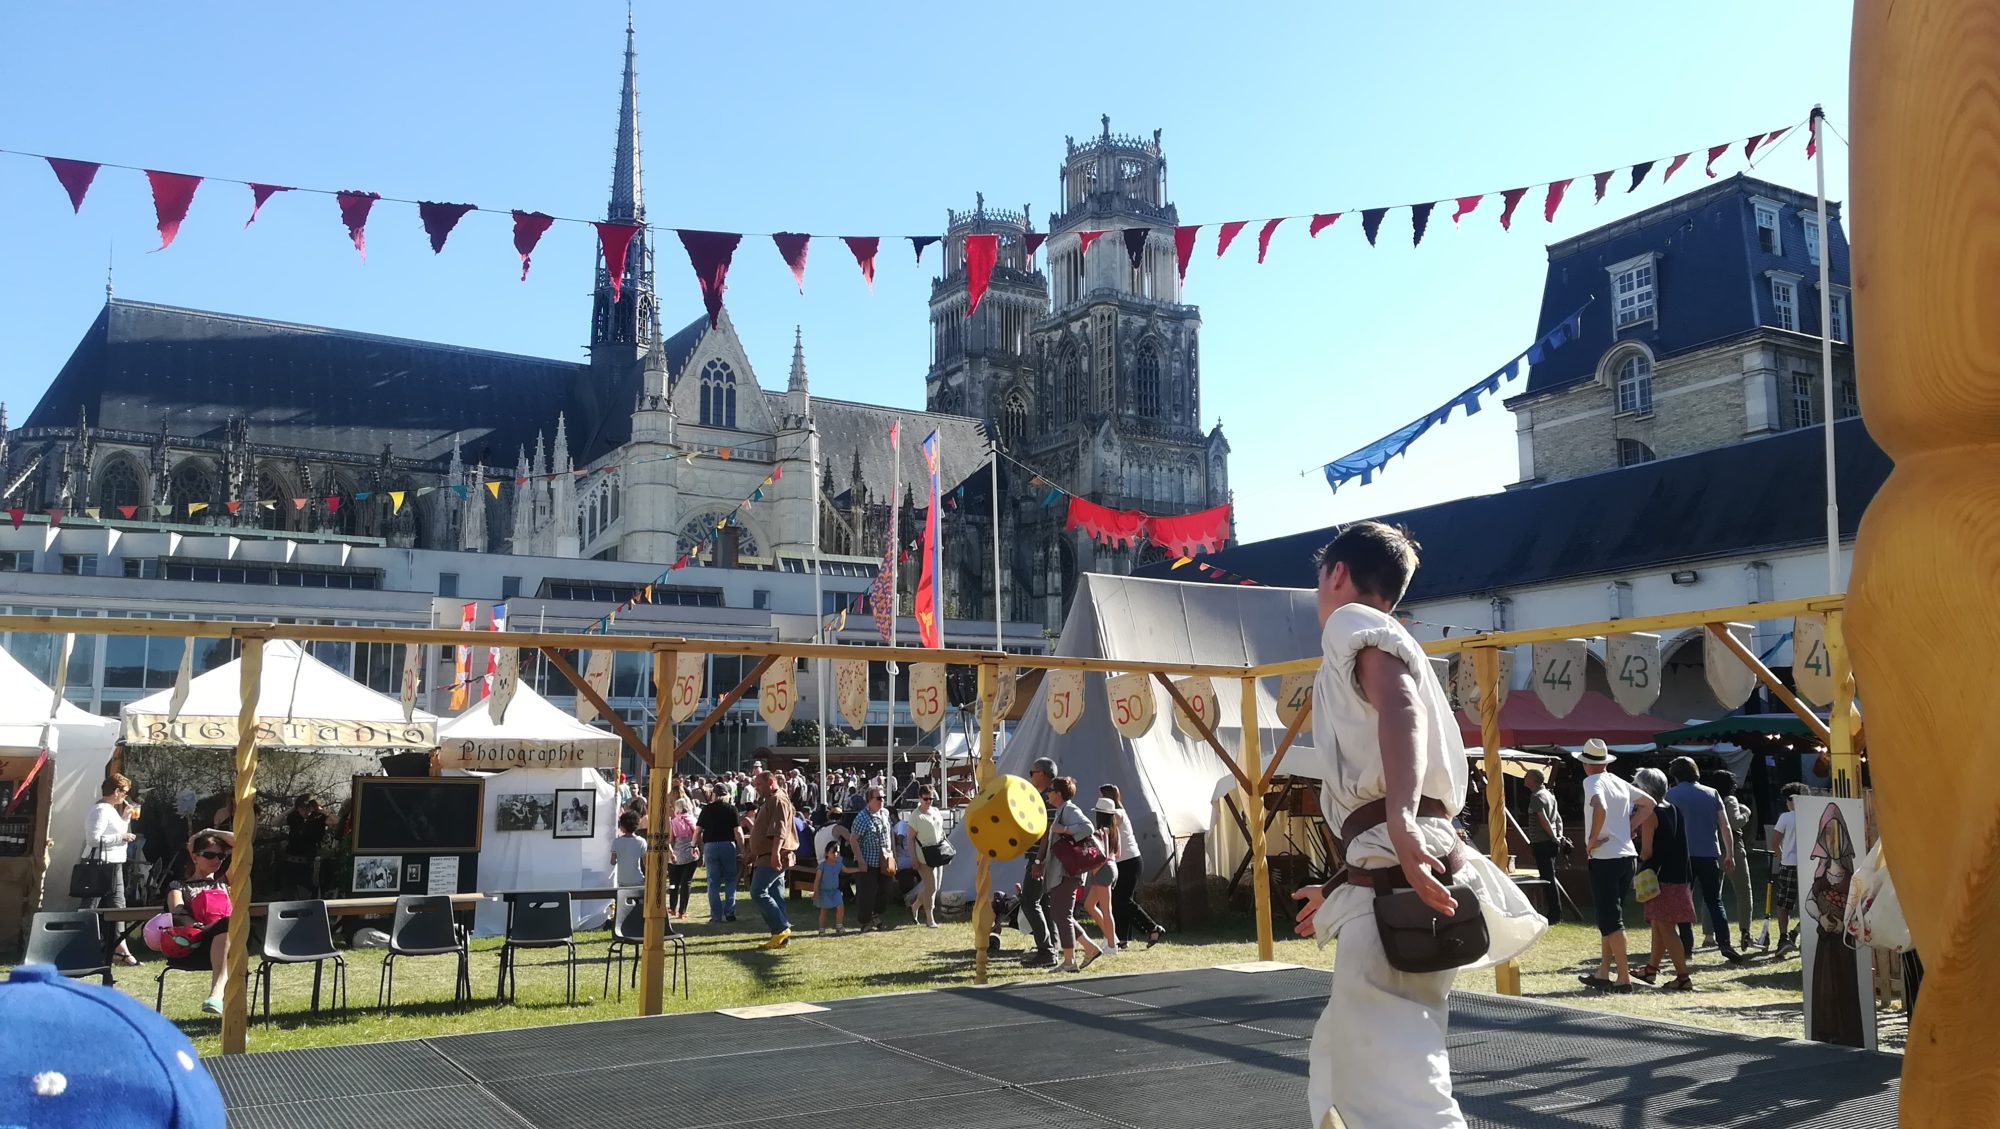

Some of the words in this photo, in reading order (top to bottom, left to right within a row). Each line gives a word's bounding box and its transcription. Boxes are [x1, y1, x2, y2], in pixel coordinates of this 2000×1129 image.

[1619, 654, 1649, 689] 43
[1804, 640, 1831, 677] 41
[1542, 658, 1573, 691] 44
[673, 675, 696, 706] 56
[766, 680, 788, 713] 55
[916, 686, 939, 717] 53
[1052, 691, 1071, 720] 51
[1116, 694, 1144, 725] 50
[1183, 694, 1206, 722] 9
[144, 721, 227, 741] BIG
[254, 720, 426, 744] STUDIO
[457, 739, 586, 769] Photographie
